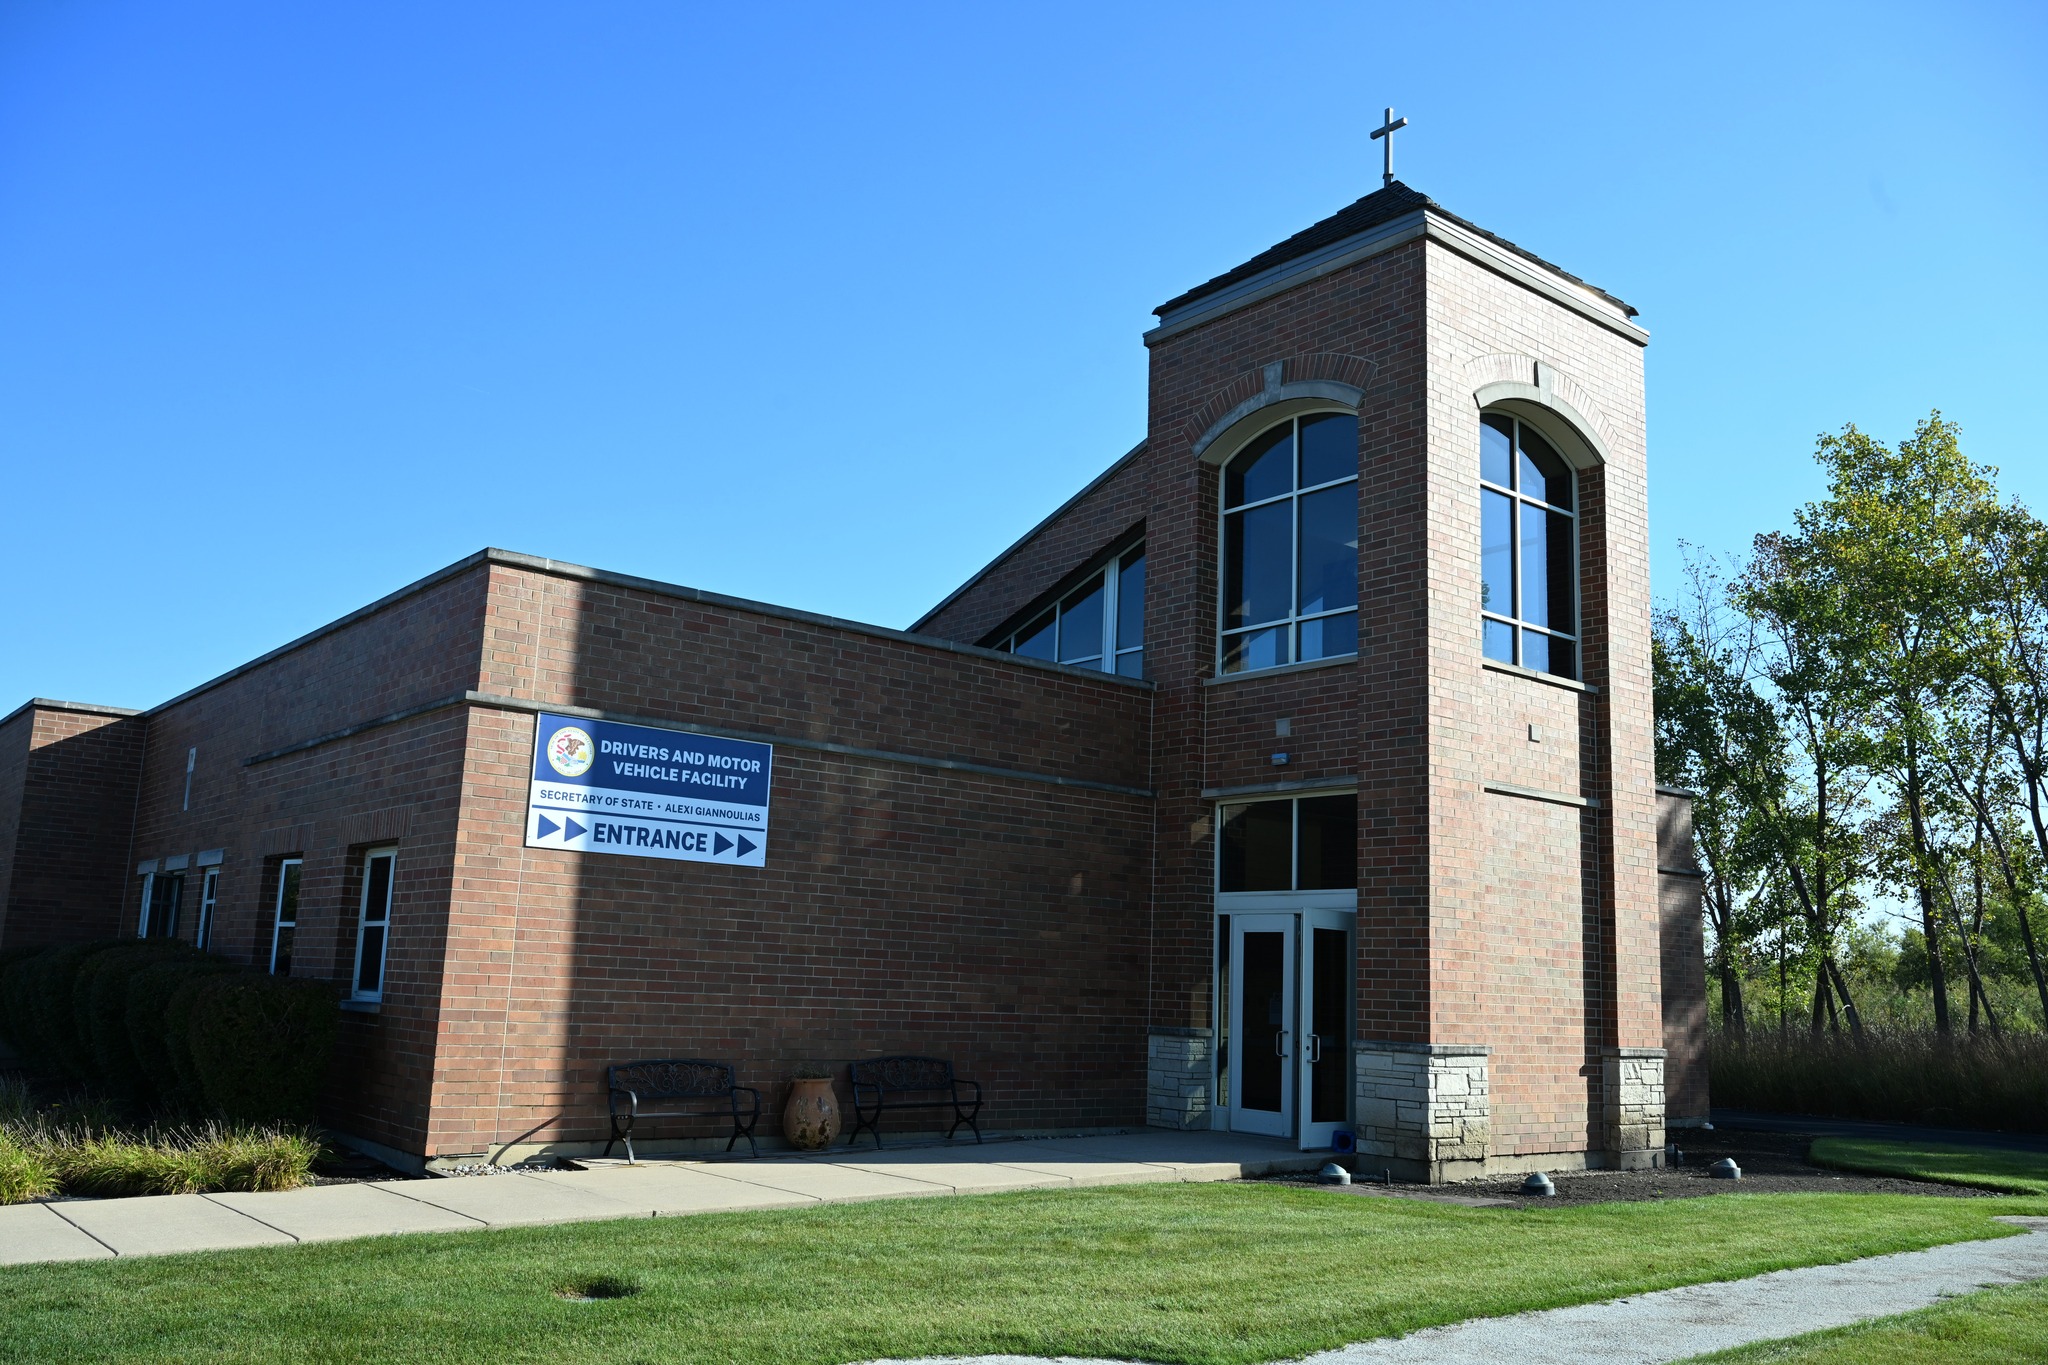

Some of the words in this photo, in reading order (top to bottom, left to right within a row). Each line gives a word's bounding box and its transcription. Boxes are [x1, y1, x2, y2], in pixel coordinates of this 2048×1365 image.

[600, 739, 669, 761] DRIVERS
[671, 749, 705, 766] AND
[707, 753, 761, 773] MOTOR
[612, 761, 679, 782] VEHICLE
[681, 770, 748, 790] FACILITY
[540, 789, 604, 805] SECRETARY
[605, 796, 619, 807] OF
[621, 798, 654, 810] STATE
[664, 803, 693, 815] ALEXI
[695, 806, 761, 822] GIANNOULIAS
[593, 822, 708, 852] ENTRANCE
